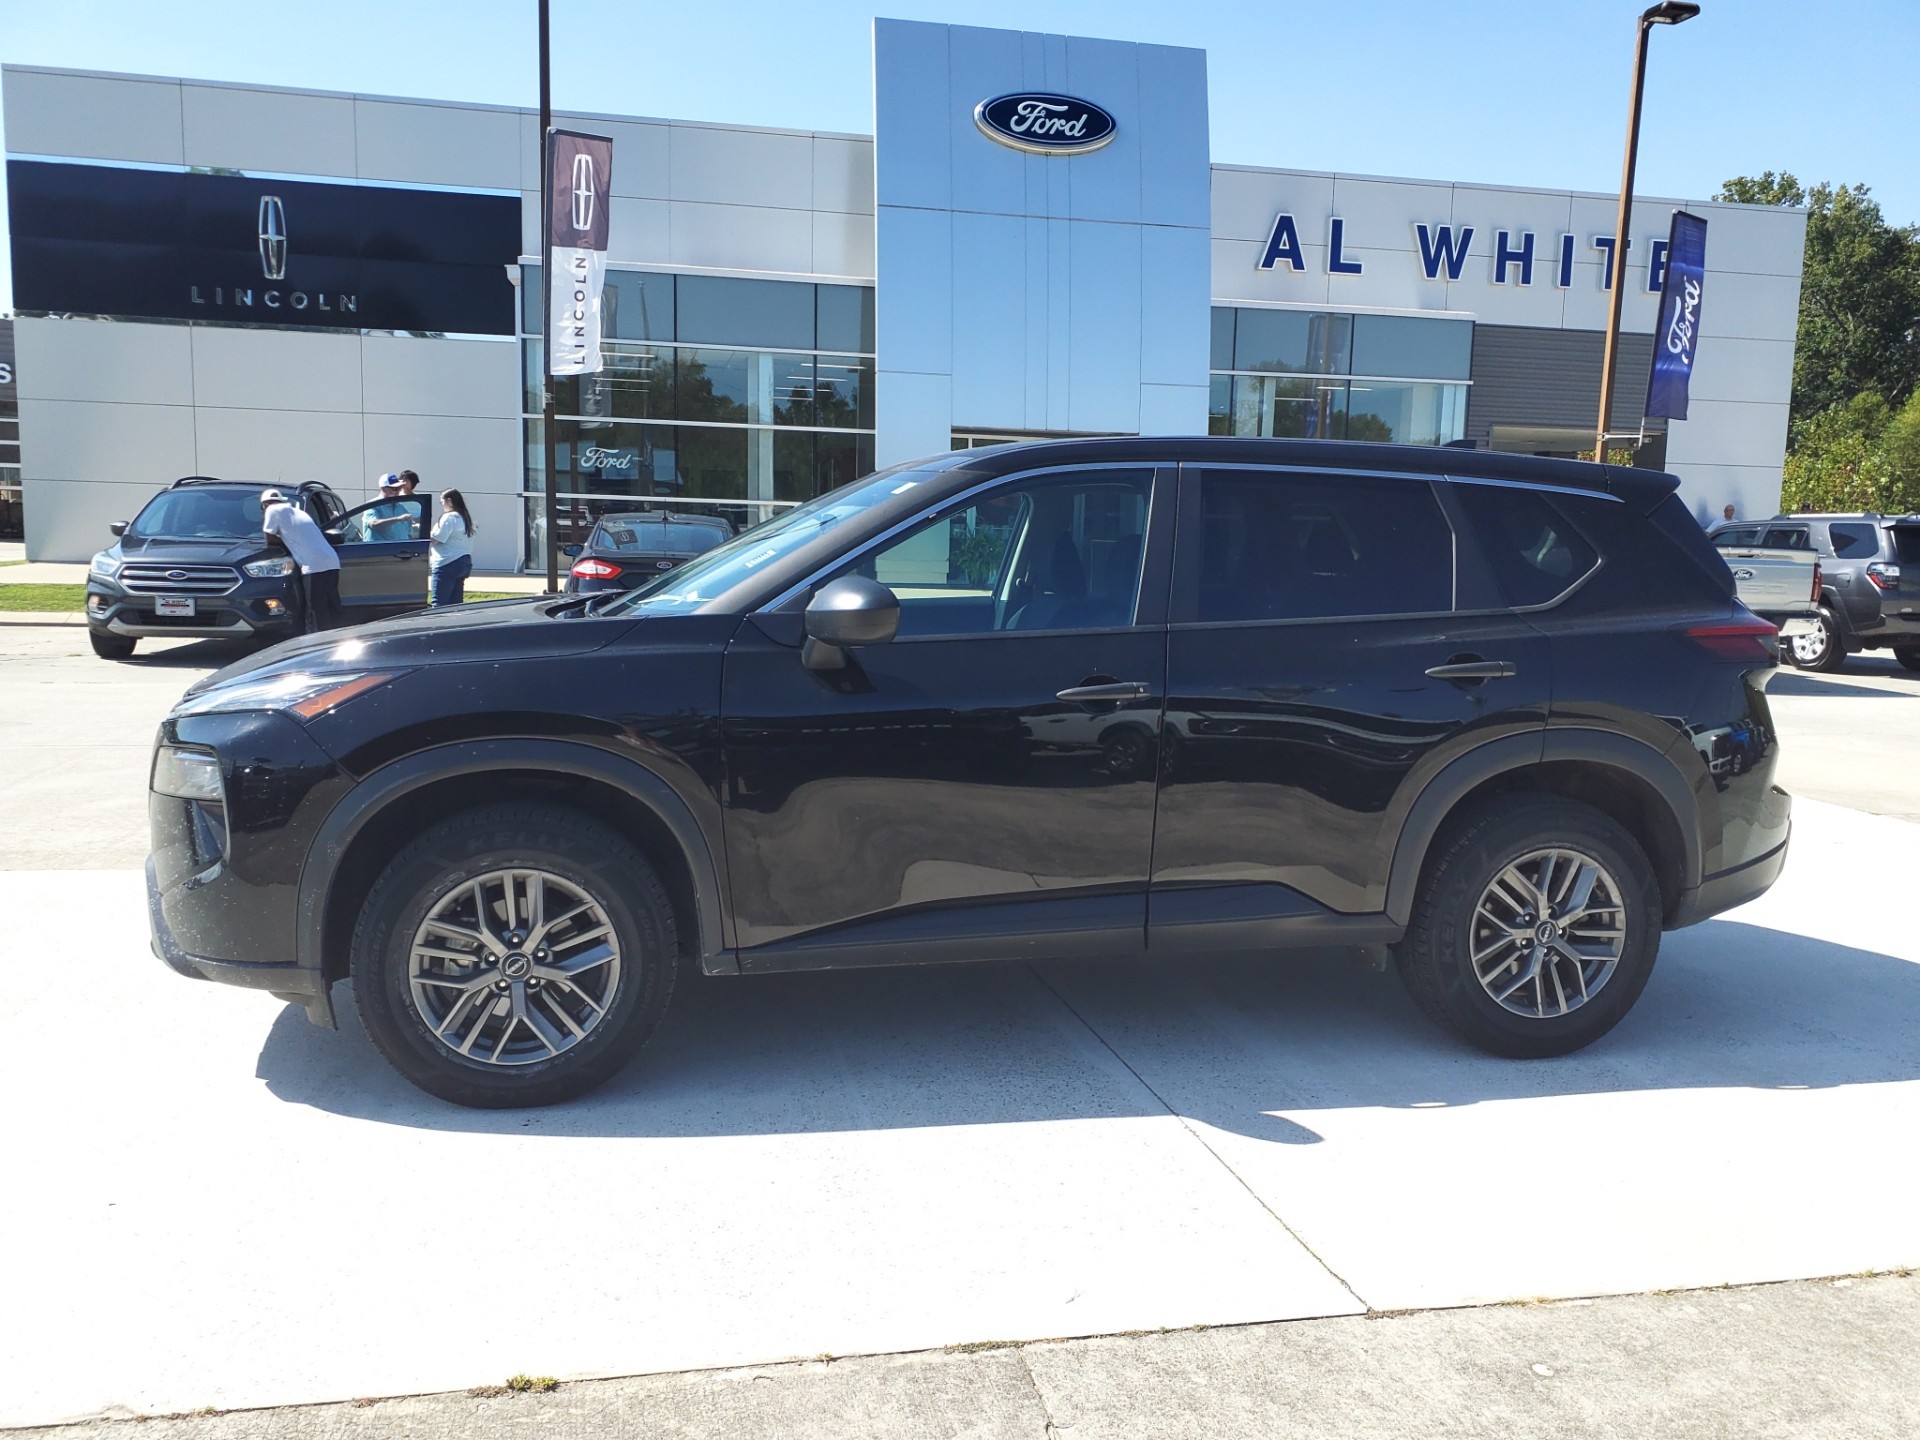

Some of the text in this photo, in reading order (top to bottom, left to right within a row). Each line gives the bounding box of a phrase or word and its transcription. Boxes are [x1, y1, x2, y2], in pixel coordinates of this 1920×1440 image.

[1010, 101, 1088, 137] Ford
[1257, 212, 1364, 276] AL
[190, 284, 358, 313] LINCOLN
[573, 257, 587, 366] LINCOLN
[1666, 274, 1701, 365] Ford
[580, 447, 632, 469] Ford
